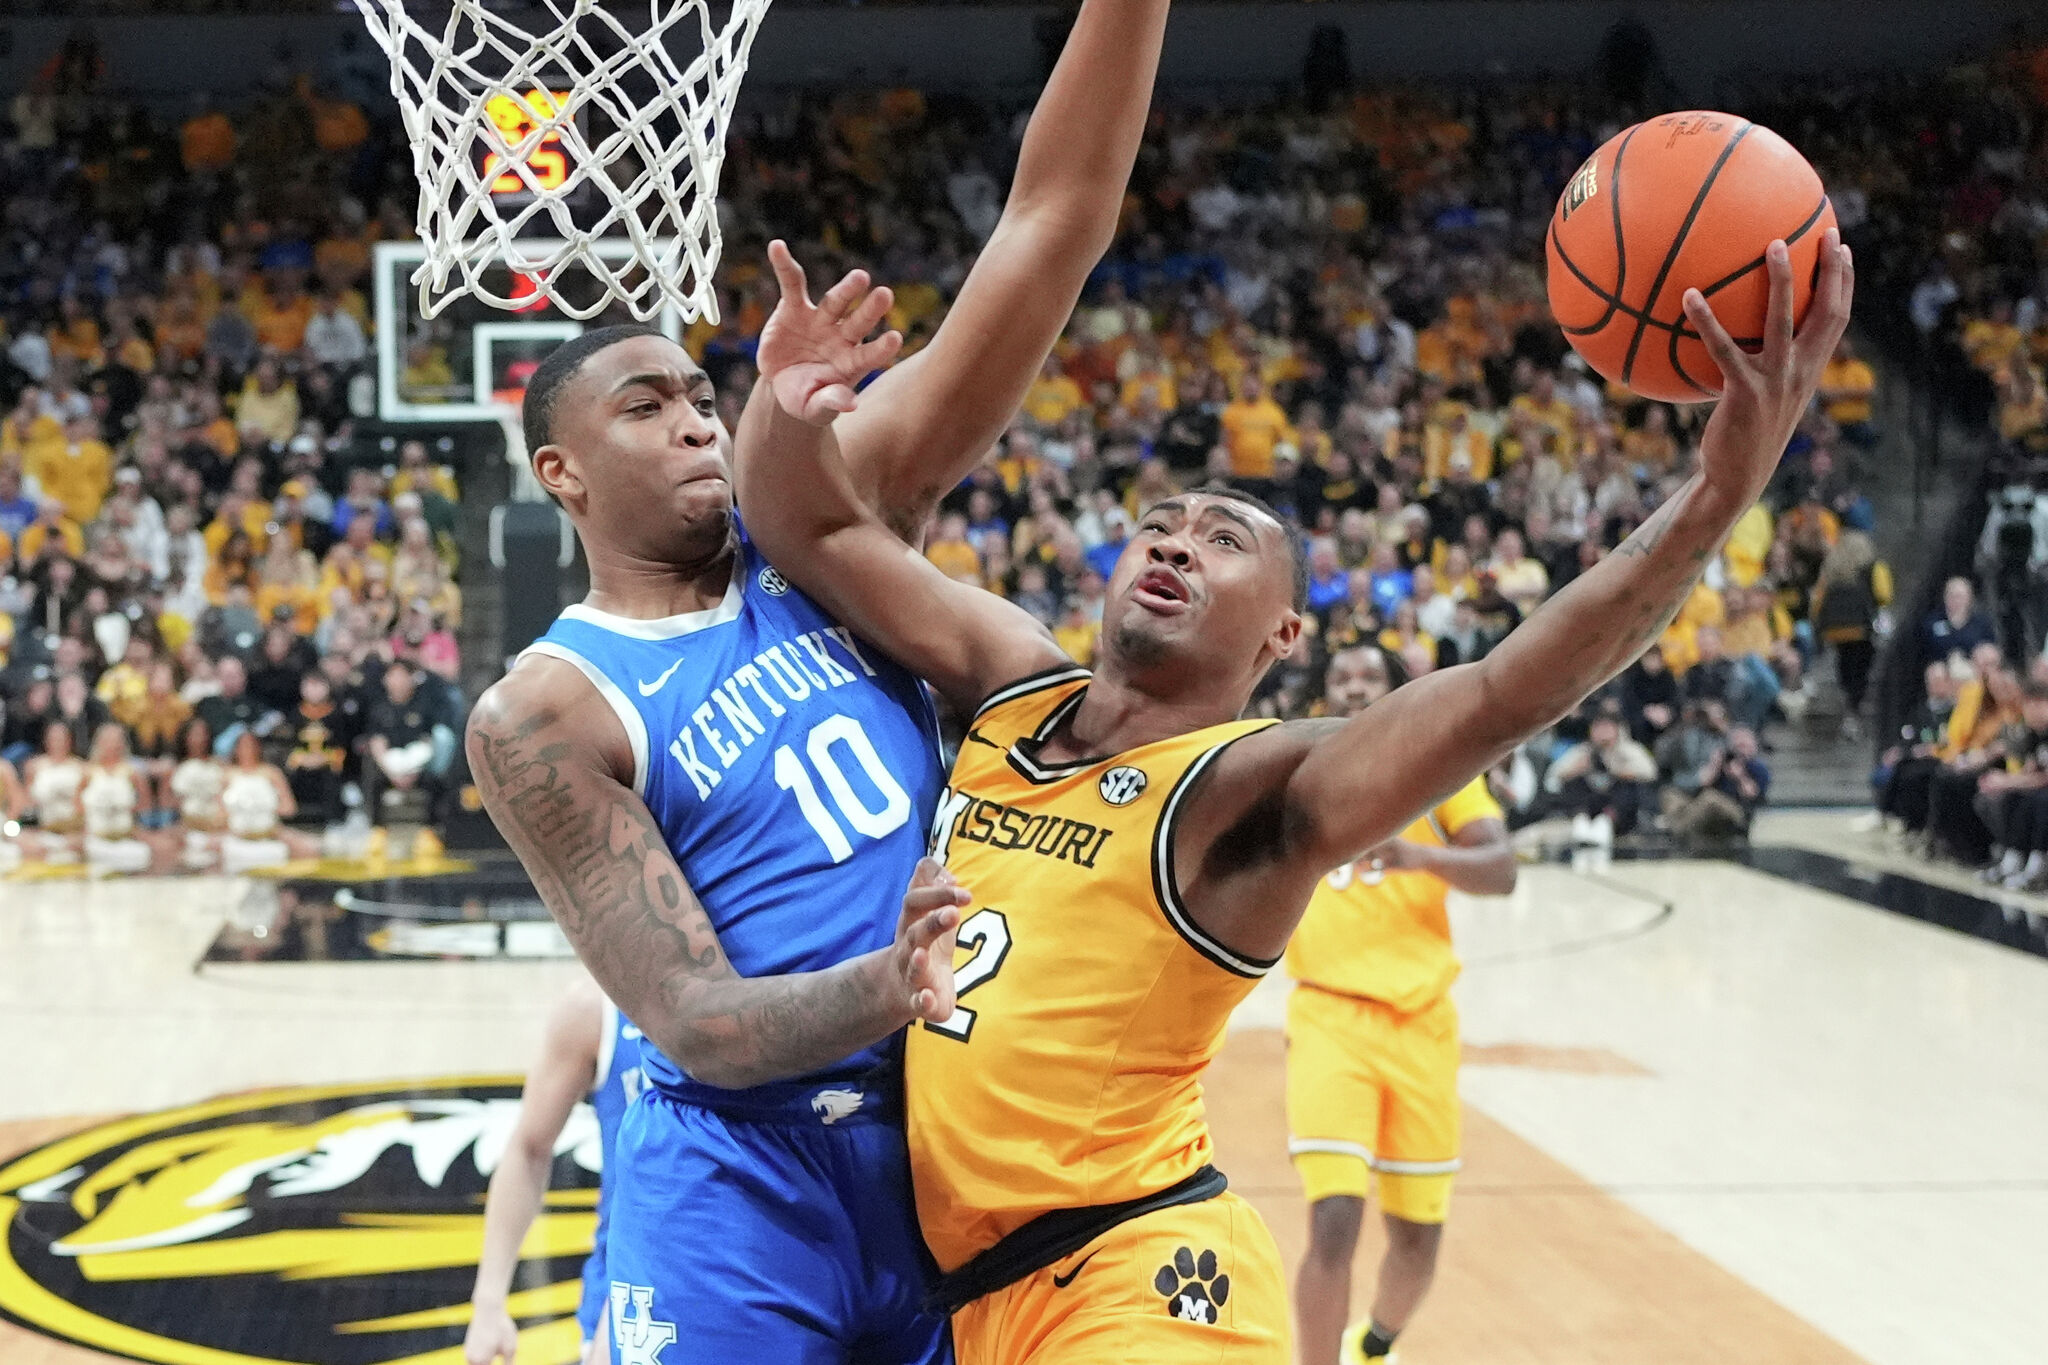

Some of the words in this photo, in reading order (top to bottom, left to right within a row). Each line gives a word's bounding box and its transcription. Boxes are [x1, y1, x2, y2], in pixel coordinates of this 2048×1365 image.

[669, 626, 878, 802] KENTUCKY
[774, 713, 911, 864] 10
[927, 785, 1114, 869] MISSOURI
[1100, 766, 1146, 804] SEC
[903, 907, 1012, 1044] 2
[1177, 1294, 1209, 1324] M
